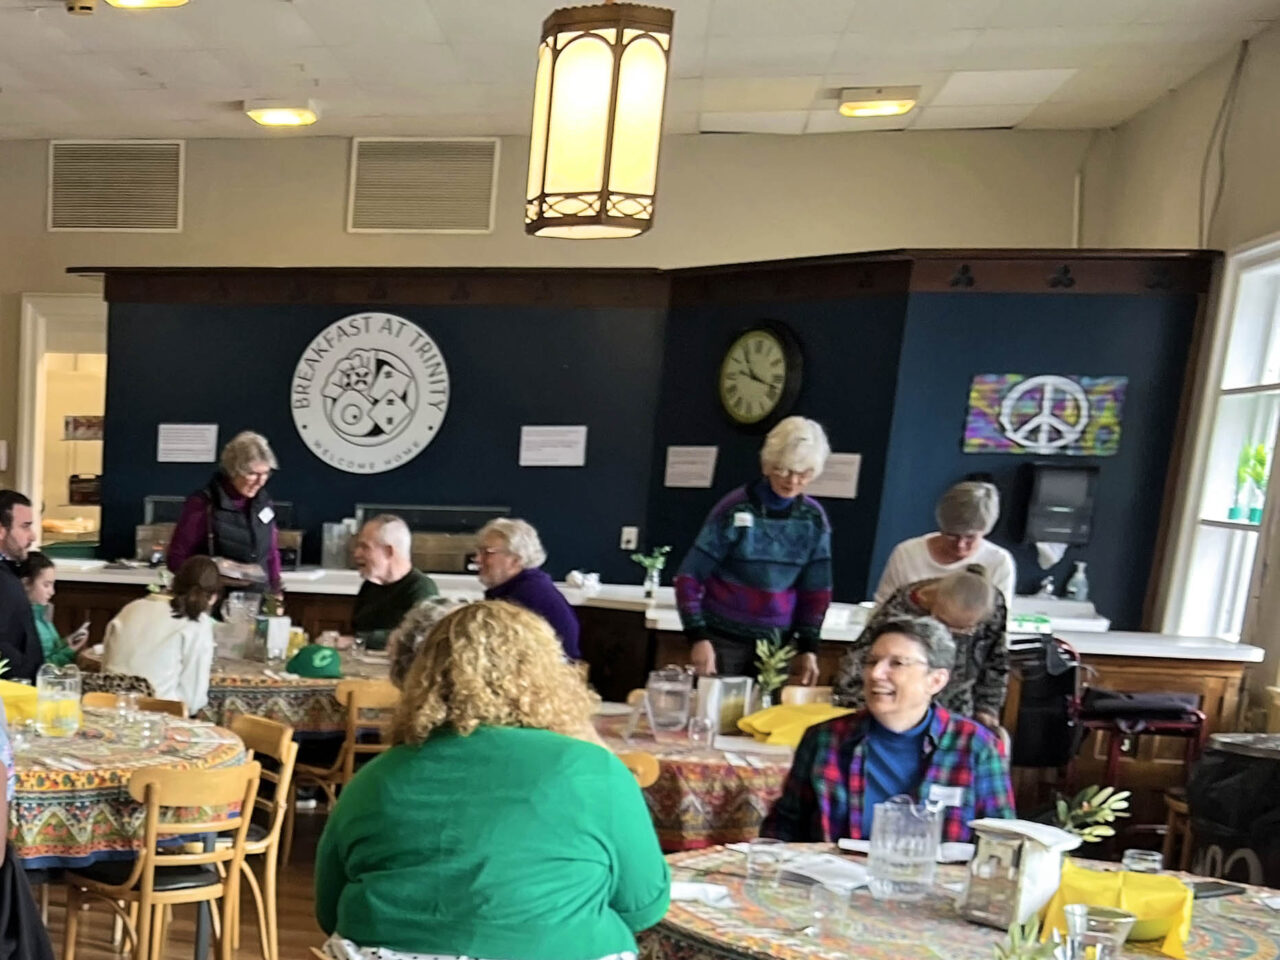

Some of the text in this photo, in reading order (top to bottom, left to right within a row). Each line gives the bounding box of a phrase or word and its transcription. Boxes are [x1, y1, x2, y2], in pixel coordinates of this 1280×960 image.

[294, 316, 448, 413] BREAKFAST AT TRINITY
[313, 439, 421, 471] WELCOME HOME
